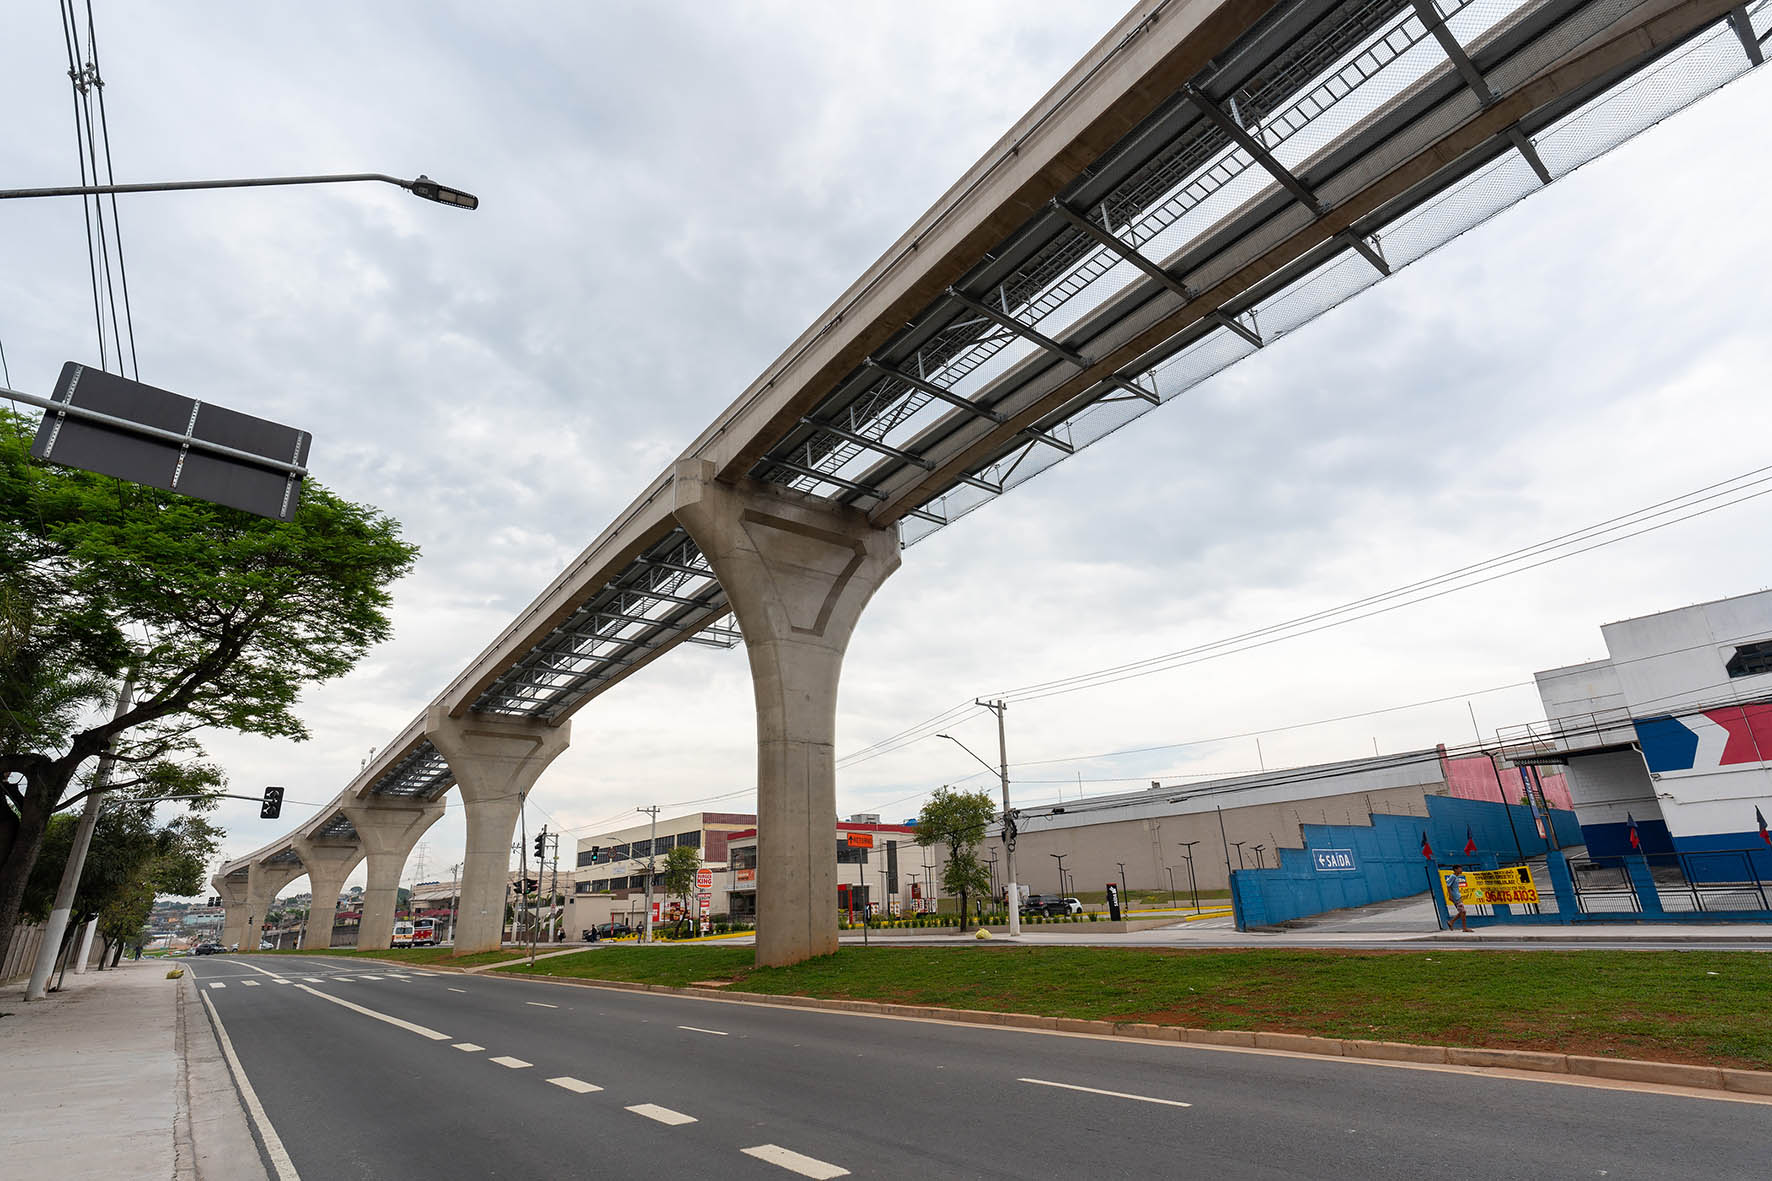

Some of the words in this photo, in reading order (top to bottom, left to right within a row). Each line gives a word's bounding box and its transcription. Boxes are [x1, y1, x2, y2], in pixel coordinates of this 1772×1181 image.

[1325, 852, 1351, 867] SAÍDA
[1485, 890, 1512, 903] 96475
[1513, 889, 1537, 902] 4103
